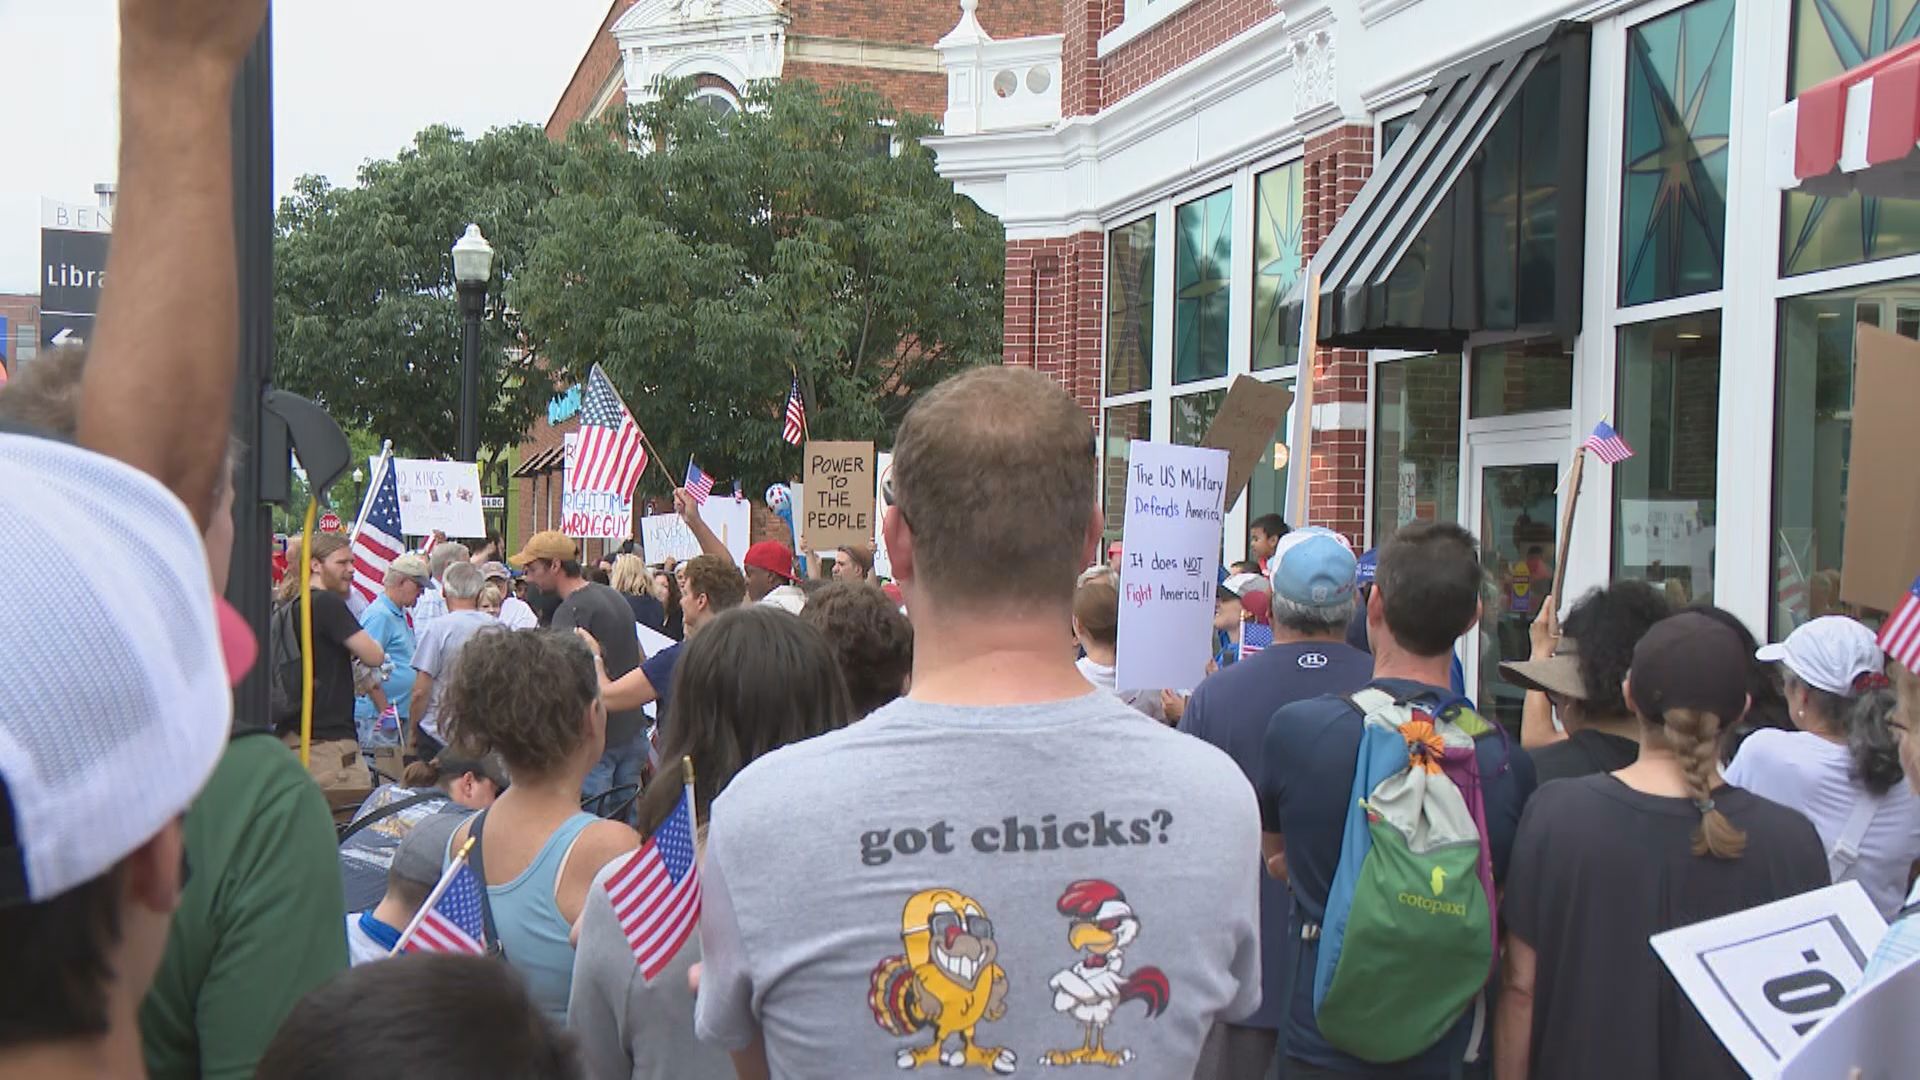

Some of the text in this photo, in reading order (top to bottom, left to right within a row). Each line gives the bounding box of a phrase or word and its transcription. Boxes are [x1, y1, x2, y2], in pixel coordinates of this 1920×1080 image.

[812, 455, 864, 475] POWER
[415, 471, 445, 487] KINGS
[827, 475, 848, 490] TO
[1133, 463, 1223, 509] The US Military
[563, 493, 597, 512] RIGHT
[817, 491, 851, 508] THE
[1135, 495, 1180, 518] Defends
[321, 519, 340, 529] STOP
[562, 513, 630, 538] WRONG GUY
[808, 511, 867, 529] PEOPLE
[1130, 551, 1203, 571] It does NOT
[1126, 583, 1152, 608] Fight
[860, 809, 1173, 866] got chicks?
[1398, 892, 1466, 917] cotopaxi
